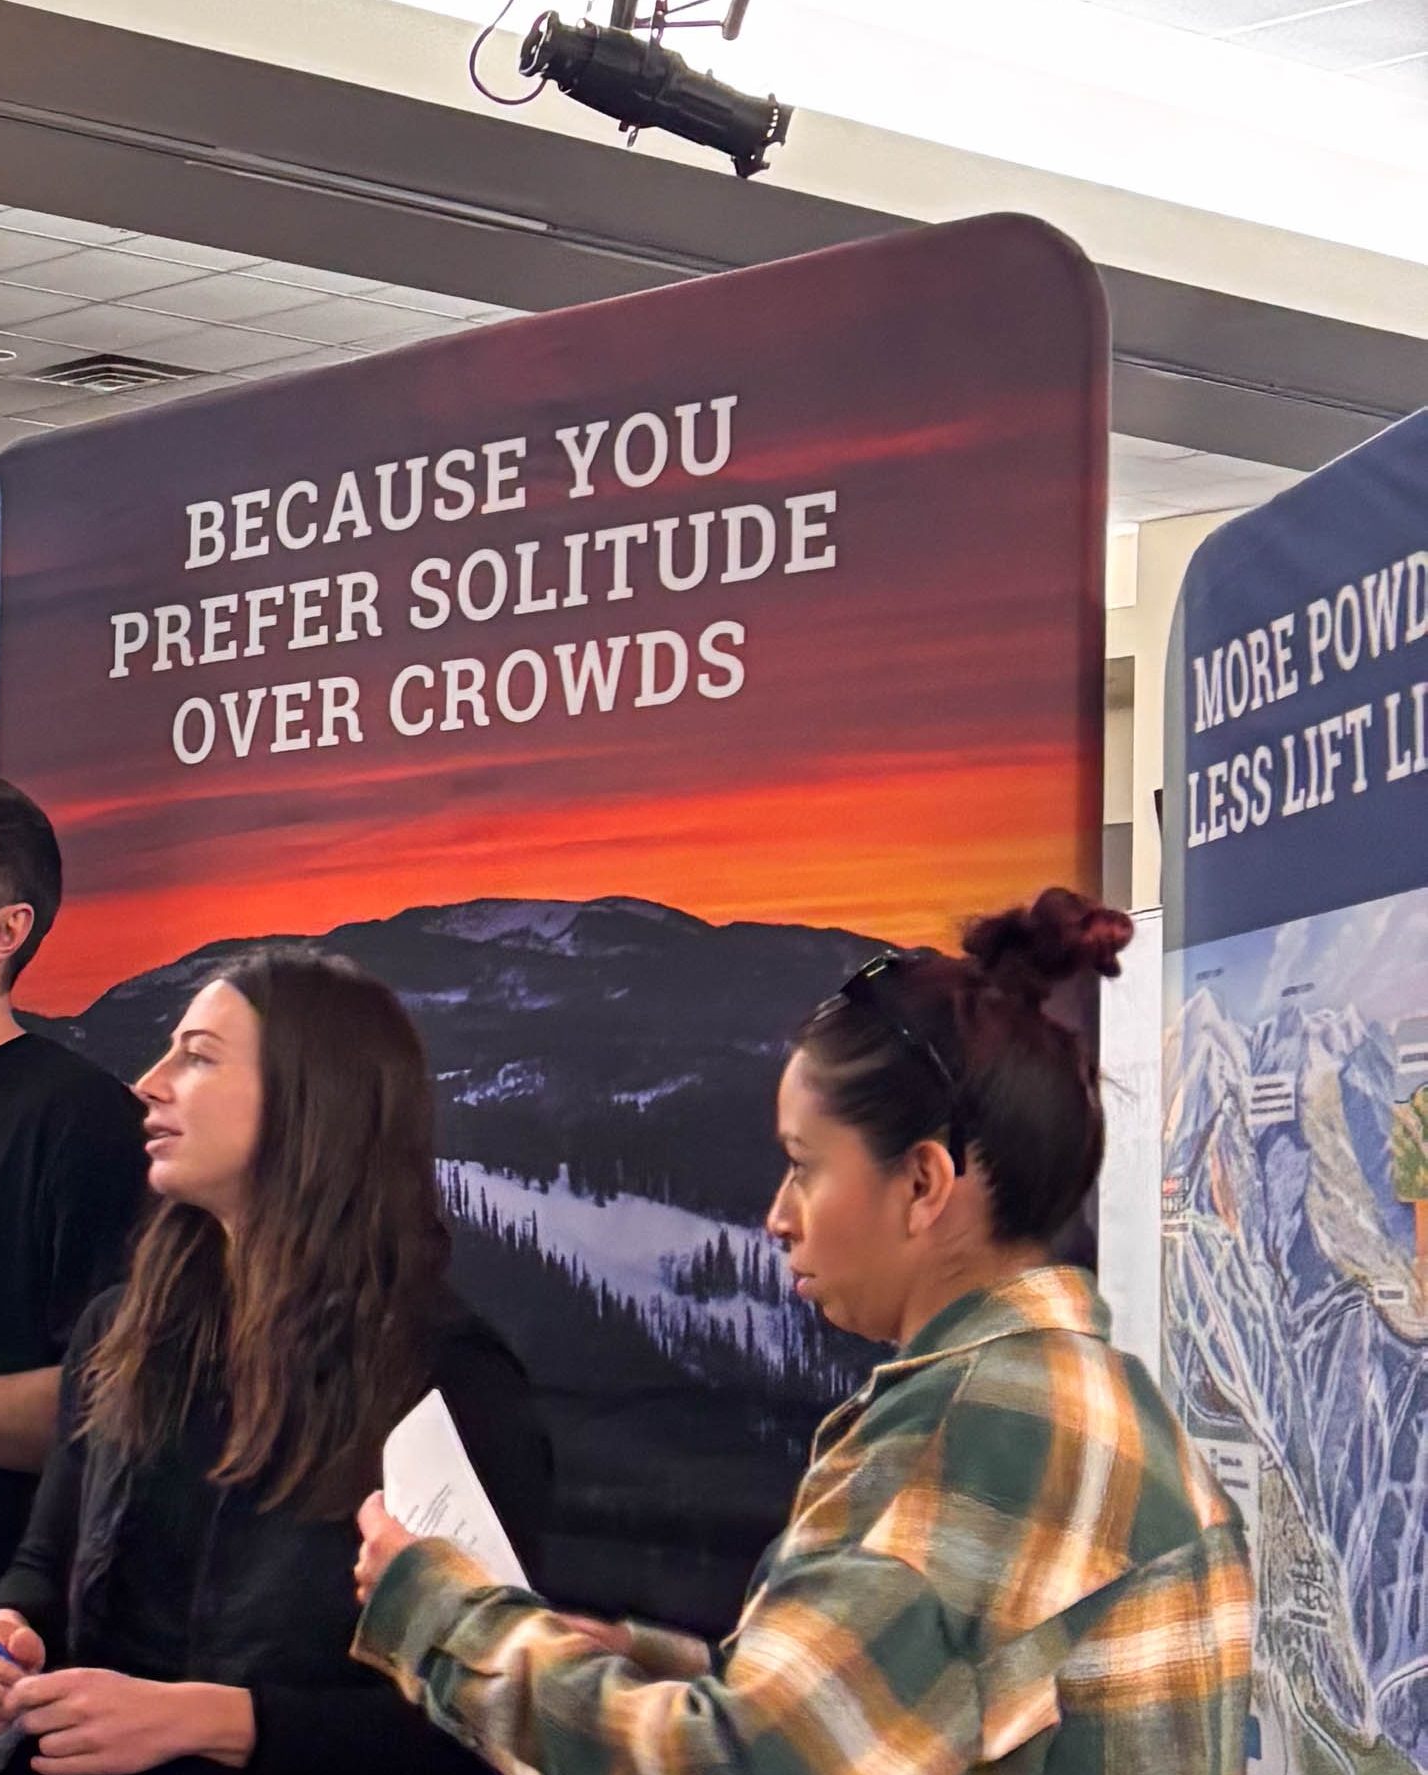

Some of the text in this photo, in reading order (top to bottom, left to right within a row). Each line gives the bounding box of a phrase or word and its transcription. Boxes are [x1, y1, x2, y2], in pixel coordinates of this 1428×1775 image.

[185, 395, 738, 570] BECAUSE YOU
[109, 490, 838, 680] PREFER SOLITUDE
[172, 620, 745, 765] OVER CROWDS
[1193, 612, 1299, 734] MORE
[1187, 745, 1273, 848] LESS
[1281, 703, 1372, 817] LIFT
